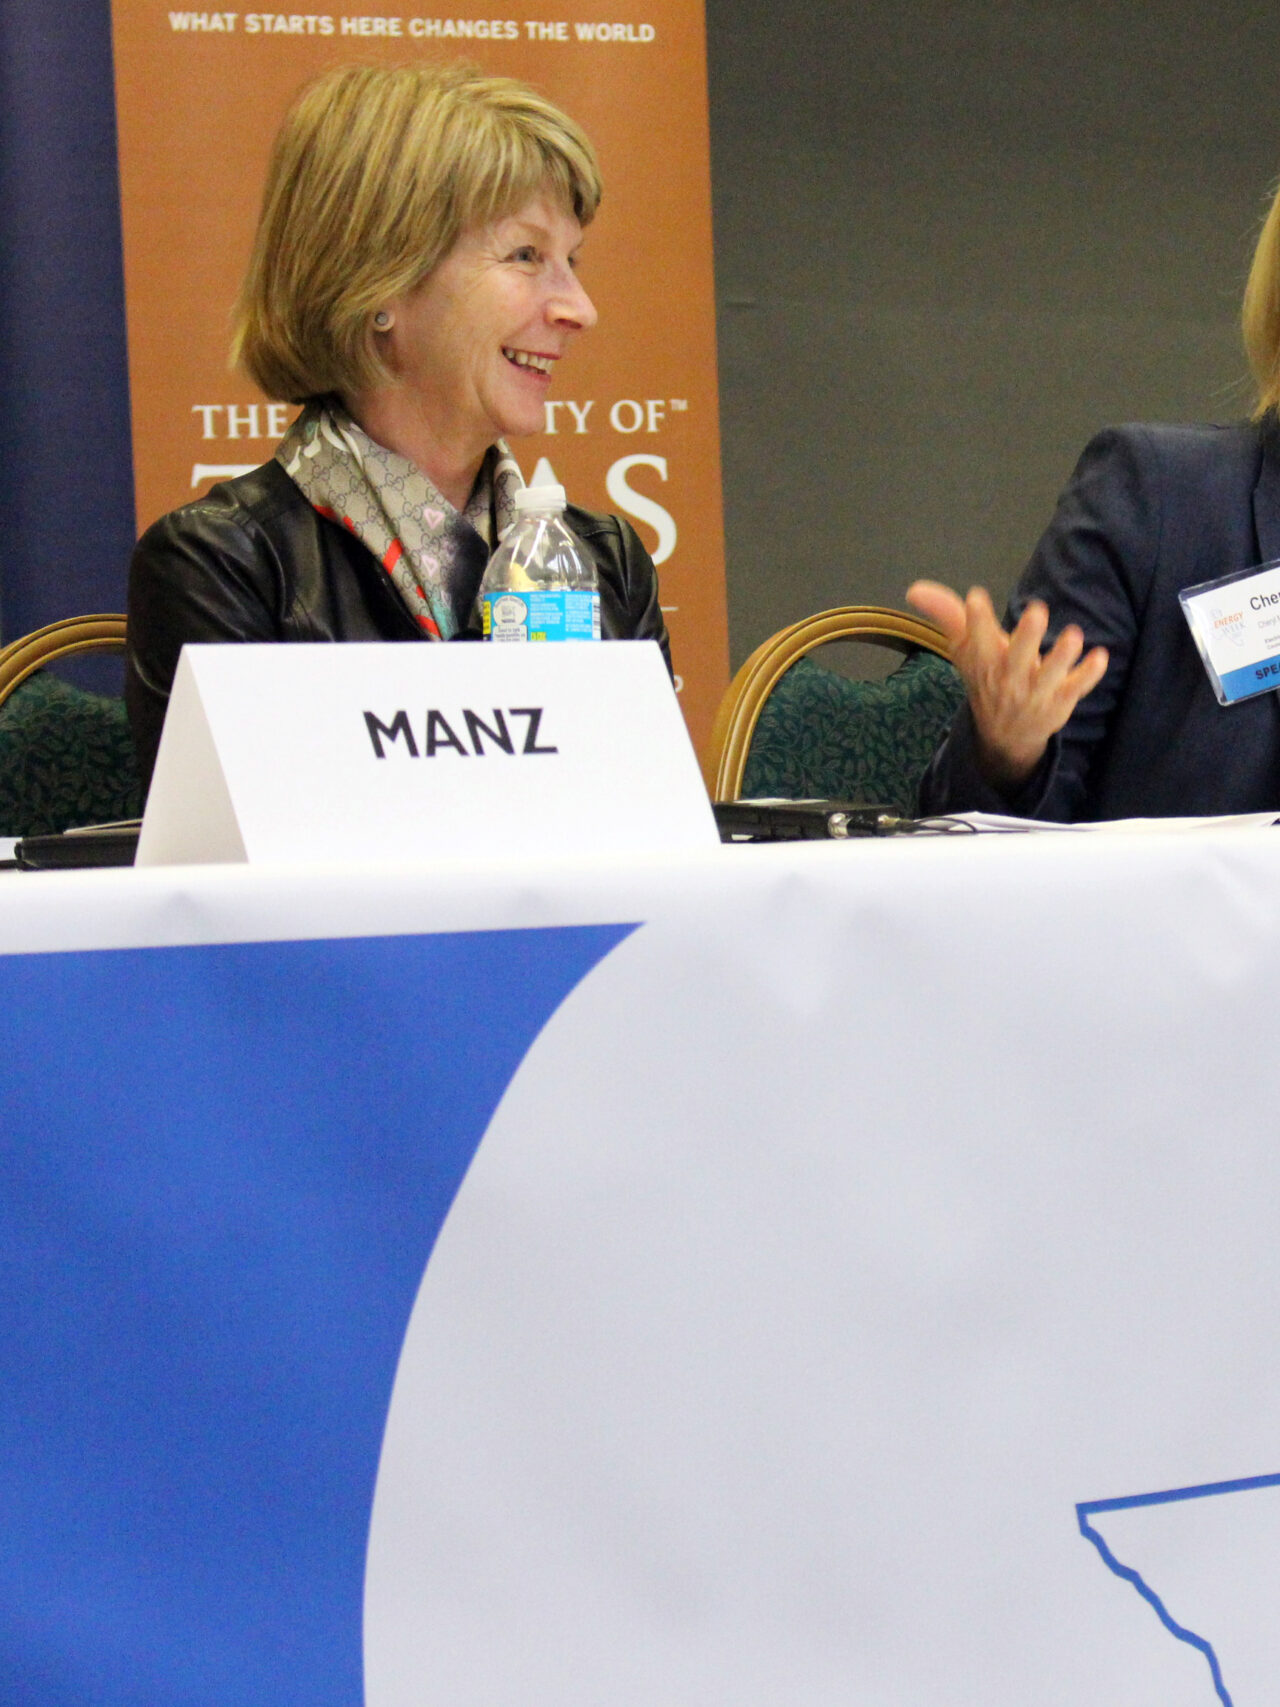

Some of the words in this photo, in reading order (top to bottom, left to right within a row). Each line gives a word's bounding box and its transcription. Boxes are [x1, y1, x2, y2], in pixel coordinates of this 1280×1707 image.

[168, 12, 238, 32] WHAT
[244, 13, 334, 35] STARTS
[340, 16, 403, 37] HERE
[408, 18, 518, 40] CHANGES
[525, 21, 569, 41] THE
[574, 22, 655, 42] WORLD
[191, 404, 288, 439] THE
[362, 708, 559, 760] MANZ
